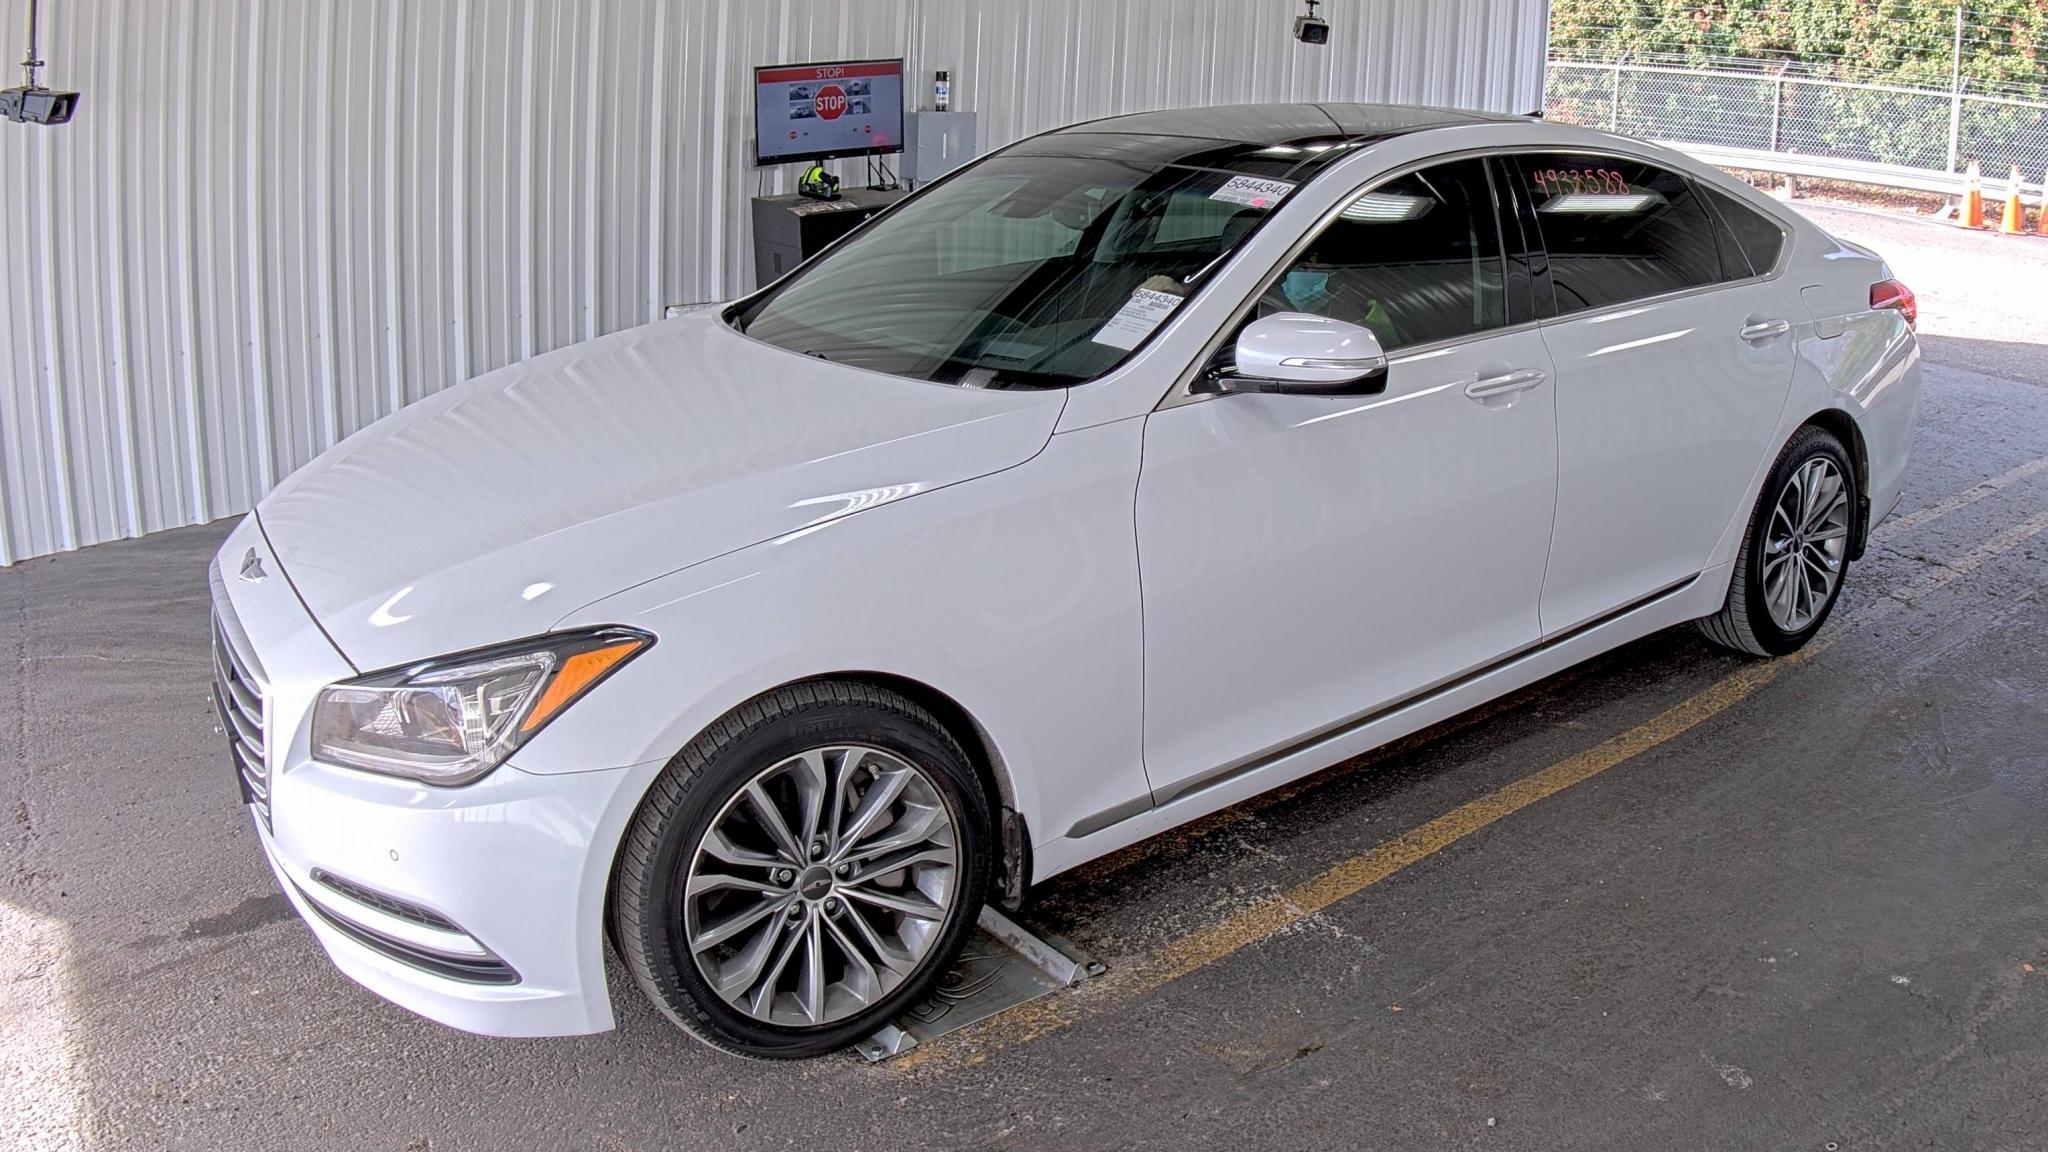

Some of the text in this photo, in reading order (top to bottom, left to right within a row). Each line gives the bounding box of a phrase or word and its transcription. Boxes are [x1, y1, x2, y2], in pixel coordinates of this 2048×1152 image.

[816, 67, 845, 79] STOP!
[816, 95, 845, 111] STOP
[1227, 178, 1290, 196] 5844340
[1134, 289, 1181, 306] 5844340
